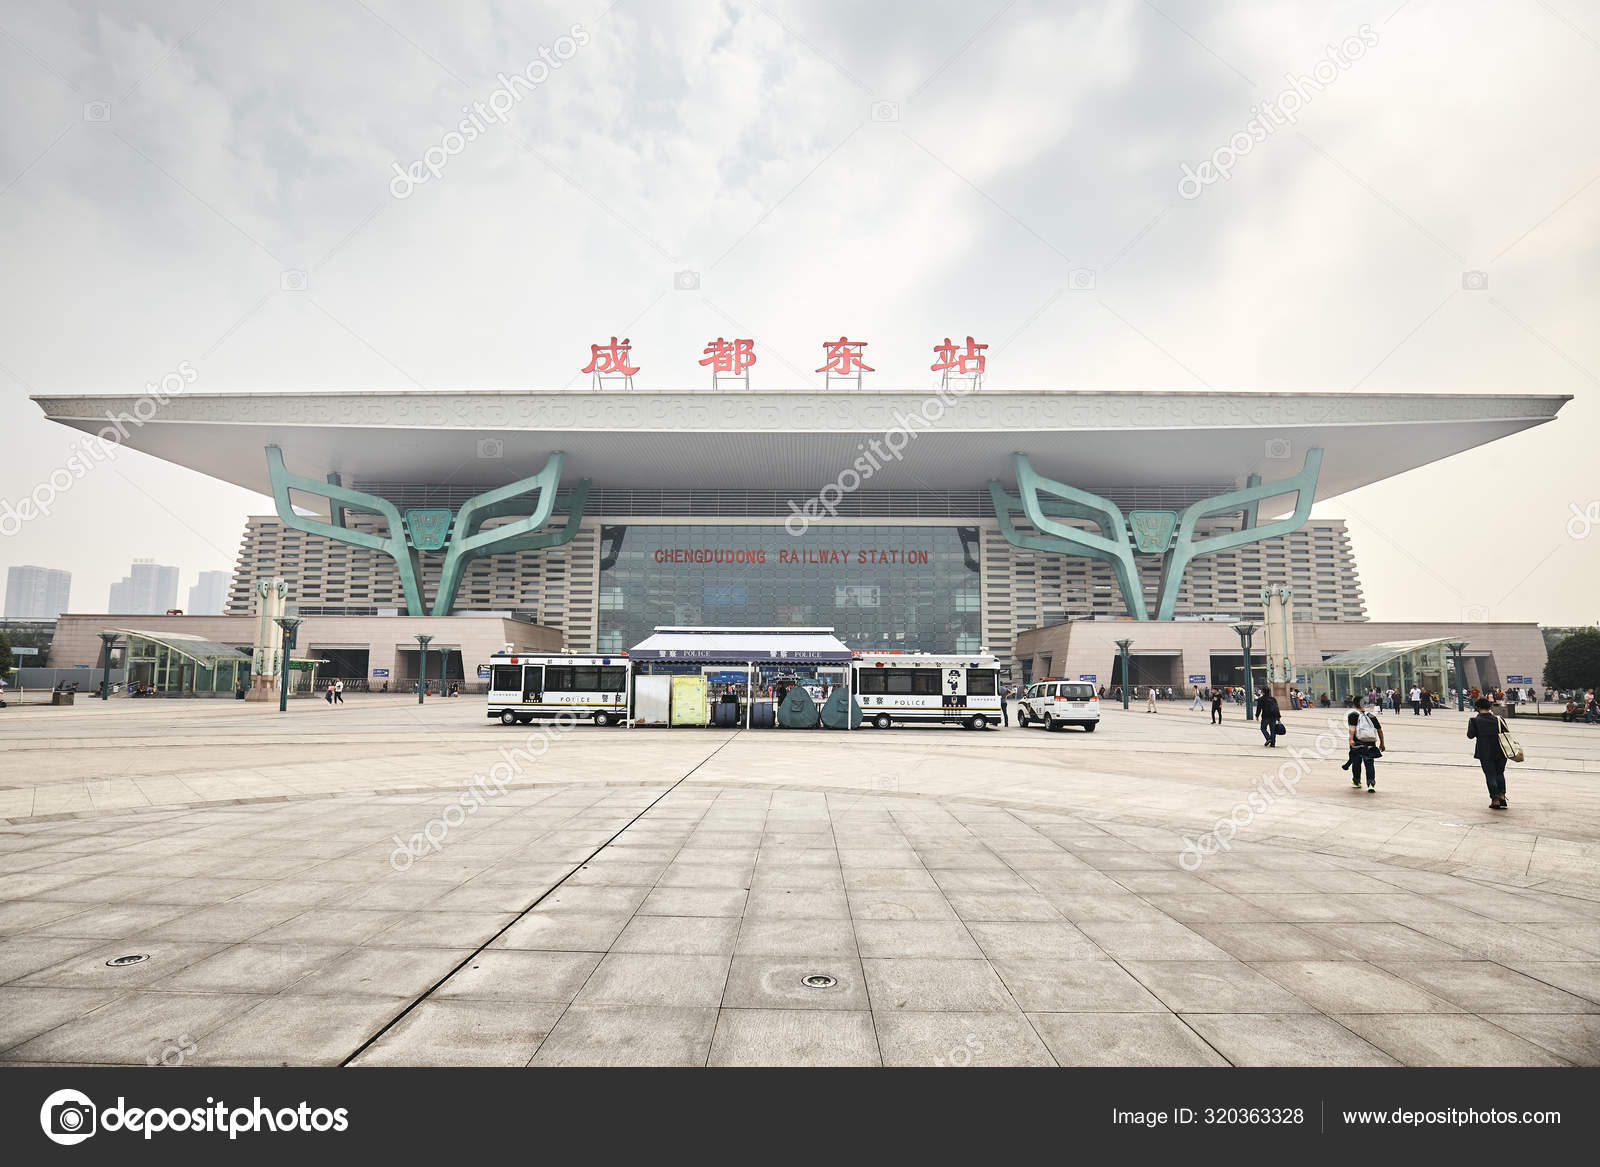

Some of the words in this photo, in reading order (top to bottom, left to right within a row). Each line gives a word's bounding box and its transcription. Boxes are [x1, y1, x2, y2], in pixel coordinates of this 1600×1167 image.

[581, 336, 989, 376] 成都东站
[654, 549, 766, 564] CHENGDUDONG
[778, 549, 850, 564] RAILWAY
[857, 549, 929, 564] STATION
[863, 696, 884, 705] 警察
